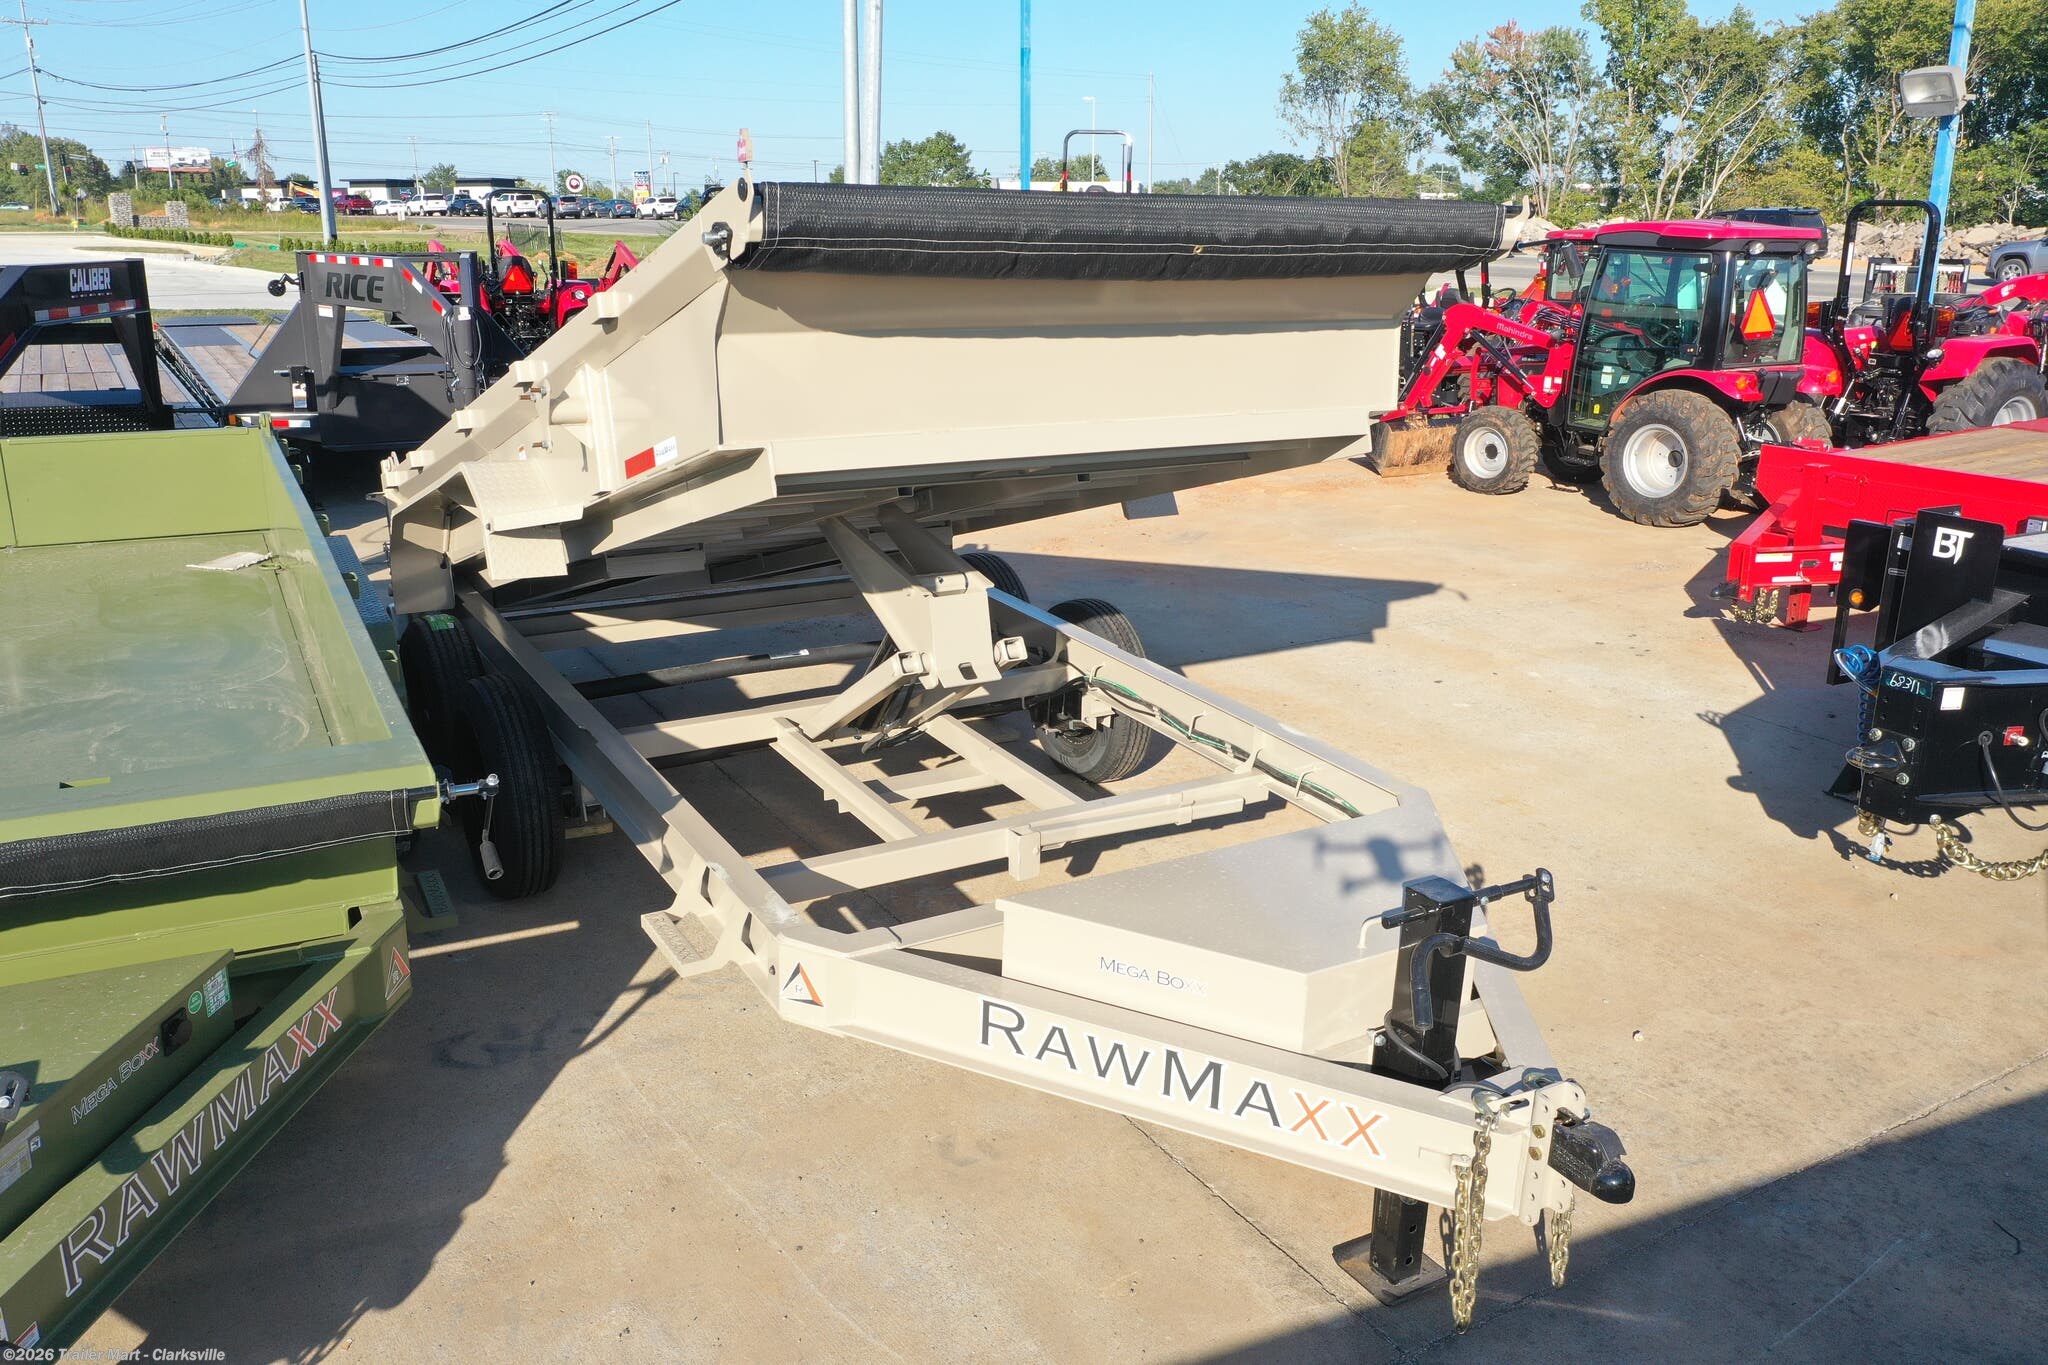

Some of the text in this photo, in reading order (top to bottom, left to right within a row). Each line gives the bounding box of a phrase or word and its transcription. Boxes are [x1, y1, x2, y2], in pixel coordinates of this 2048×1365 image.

[69, 267, 111, 292] CALIBER
[325, 271, 385, 303] RICE
[1496, 322, 1533, 341] Mahindra
[1931, 526, 1975, 565] BT
[1099, 956, 1150, 981] MEGA
[71, 1036, 160, 1125] MEGA BOXX
[979, 999, 1384, 1157] RAWMAXX
[59, 987, 342, 1297] RAWMAXX
